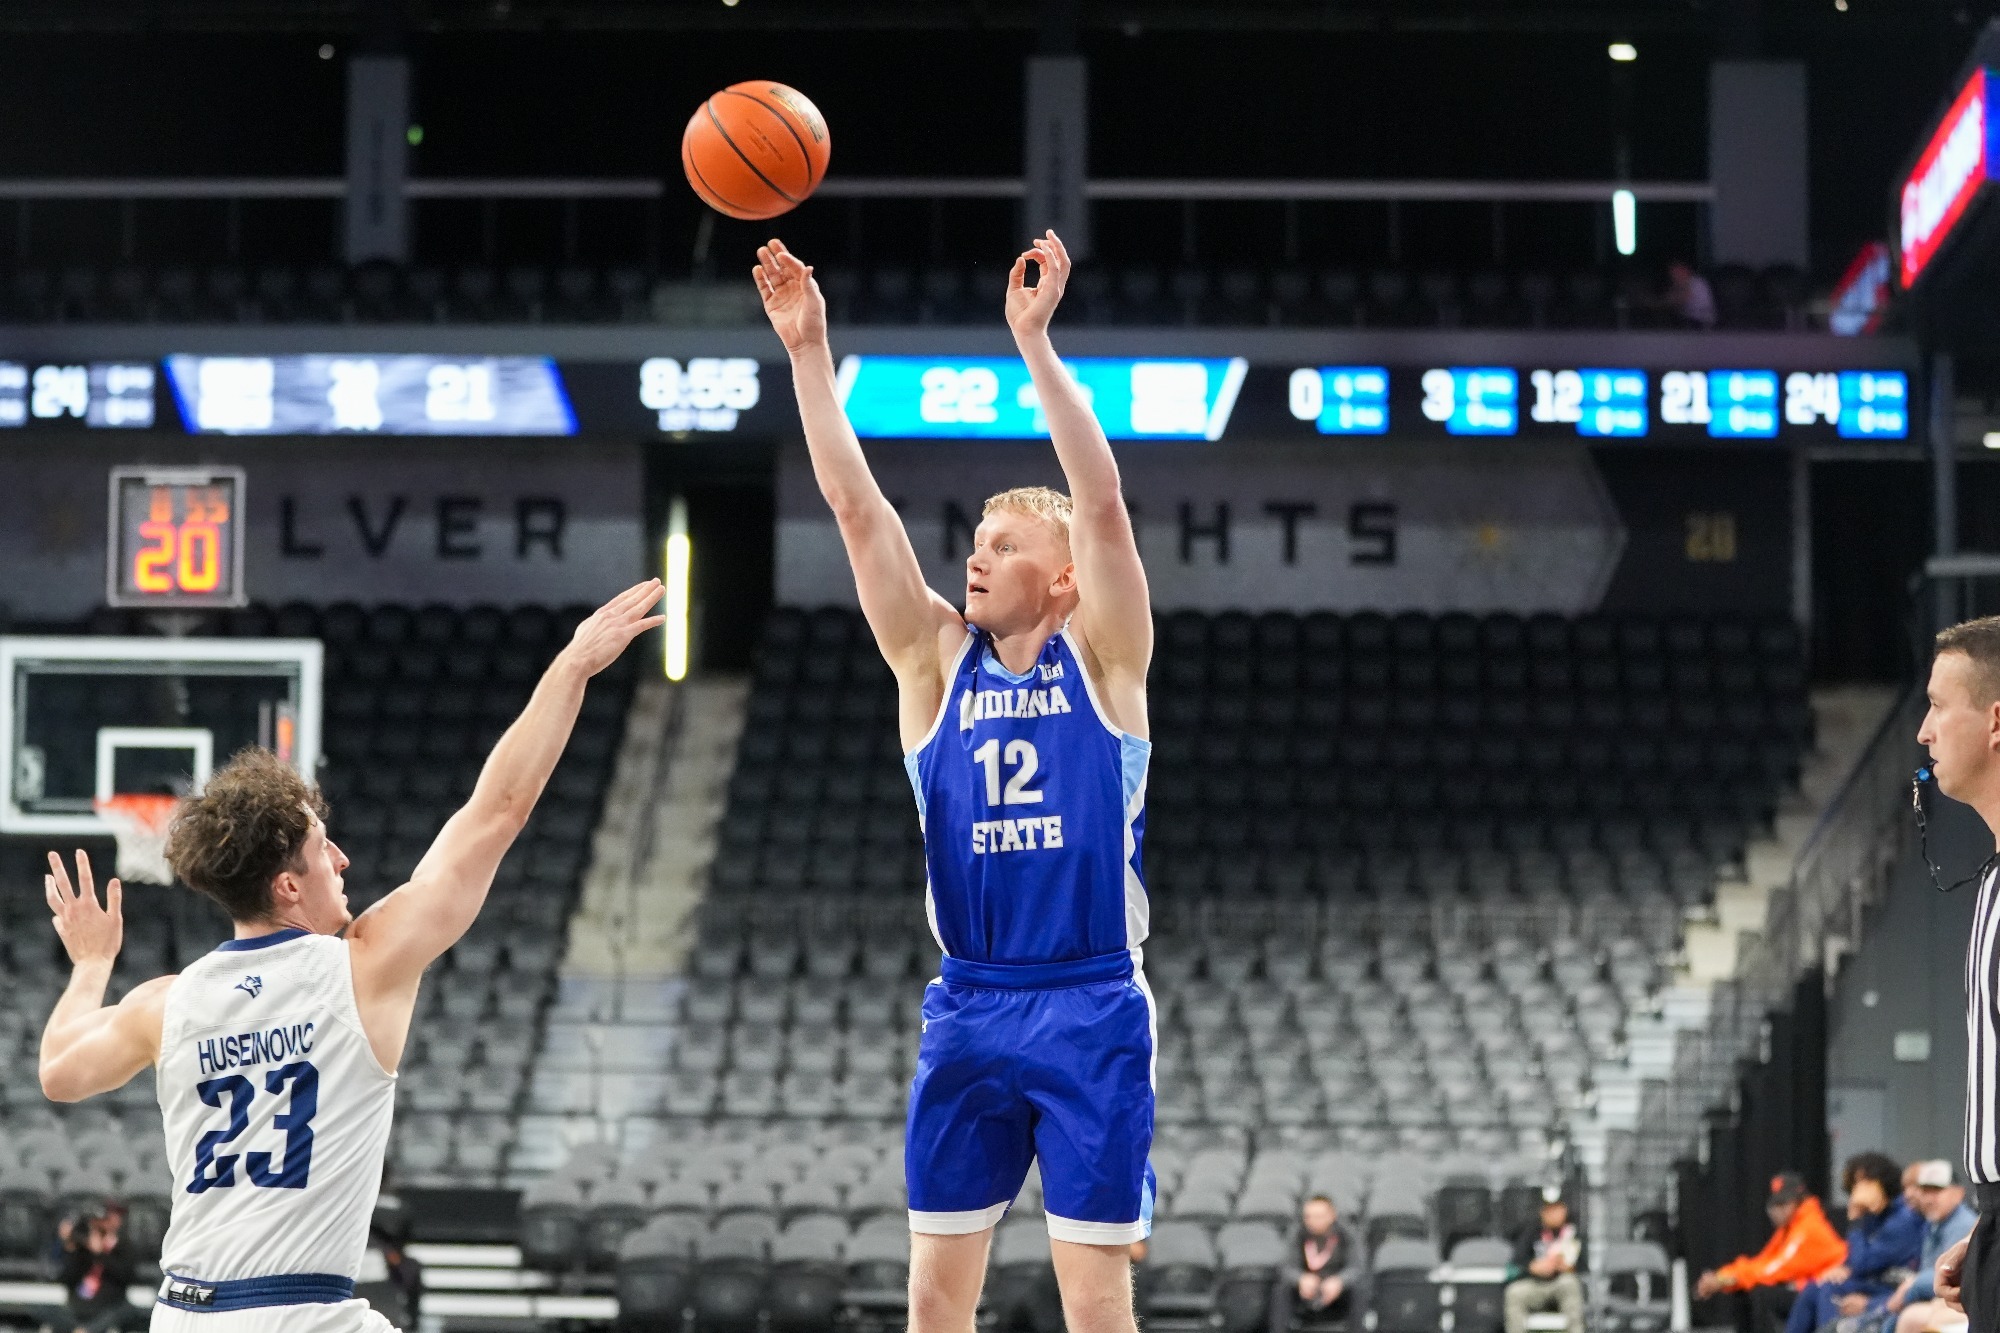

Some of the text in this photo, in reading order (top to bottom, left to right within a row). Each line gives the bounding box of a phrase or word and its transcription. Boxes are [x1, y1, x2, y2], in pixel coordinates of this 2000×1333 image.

[426, 364, 495, 421] 21
[640, 358, 760, 410] 8:55
[920, 366, 1000, 424] 22
[1289, 368, 1323, 420] 0
[1421, 368, 1455, 421] 3
[1530, 369, 1584, 422] 12
[1661, 371, 1712, 424] 21
[1785, 372, 1841, 425] 24
[135, 520, 220, 592] 20
[279, 495, 1396, 564] LVER NHTS
[973, 738, 1043, 806] 12
[972, 815, 1064, 855] STATE
[198, 1022, 314, 1074] HUSEINOVIC
[186, 1061, 319, 1194] 23
